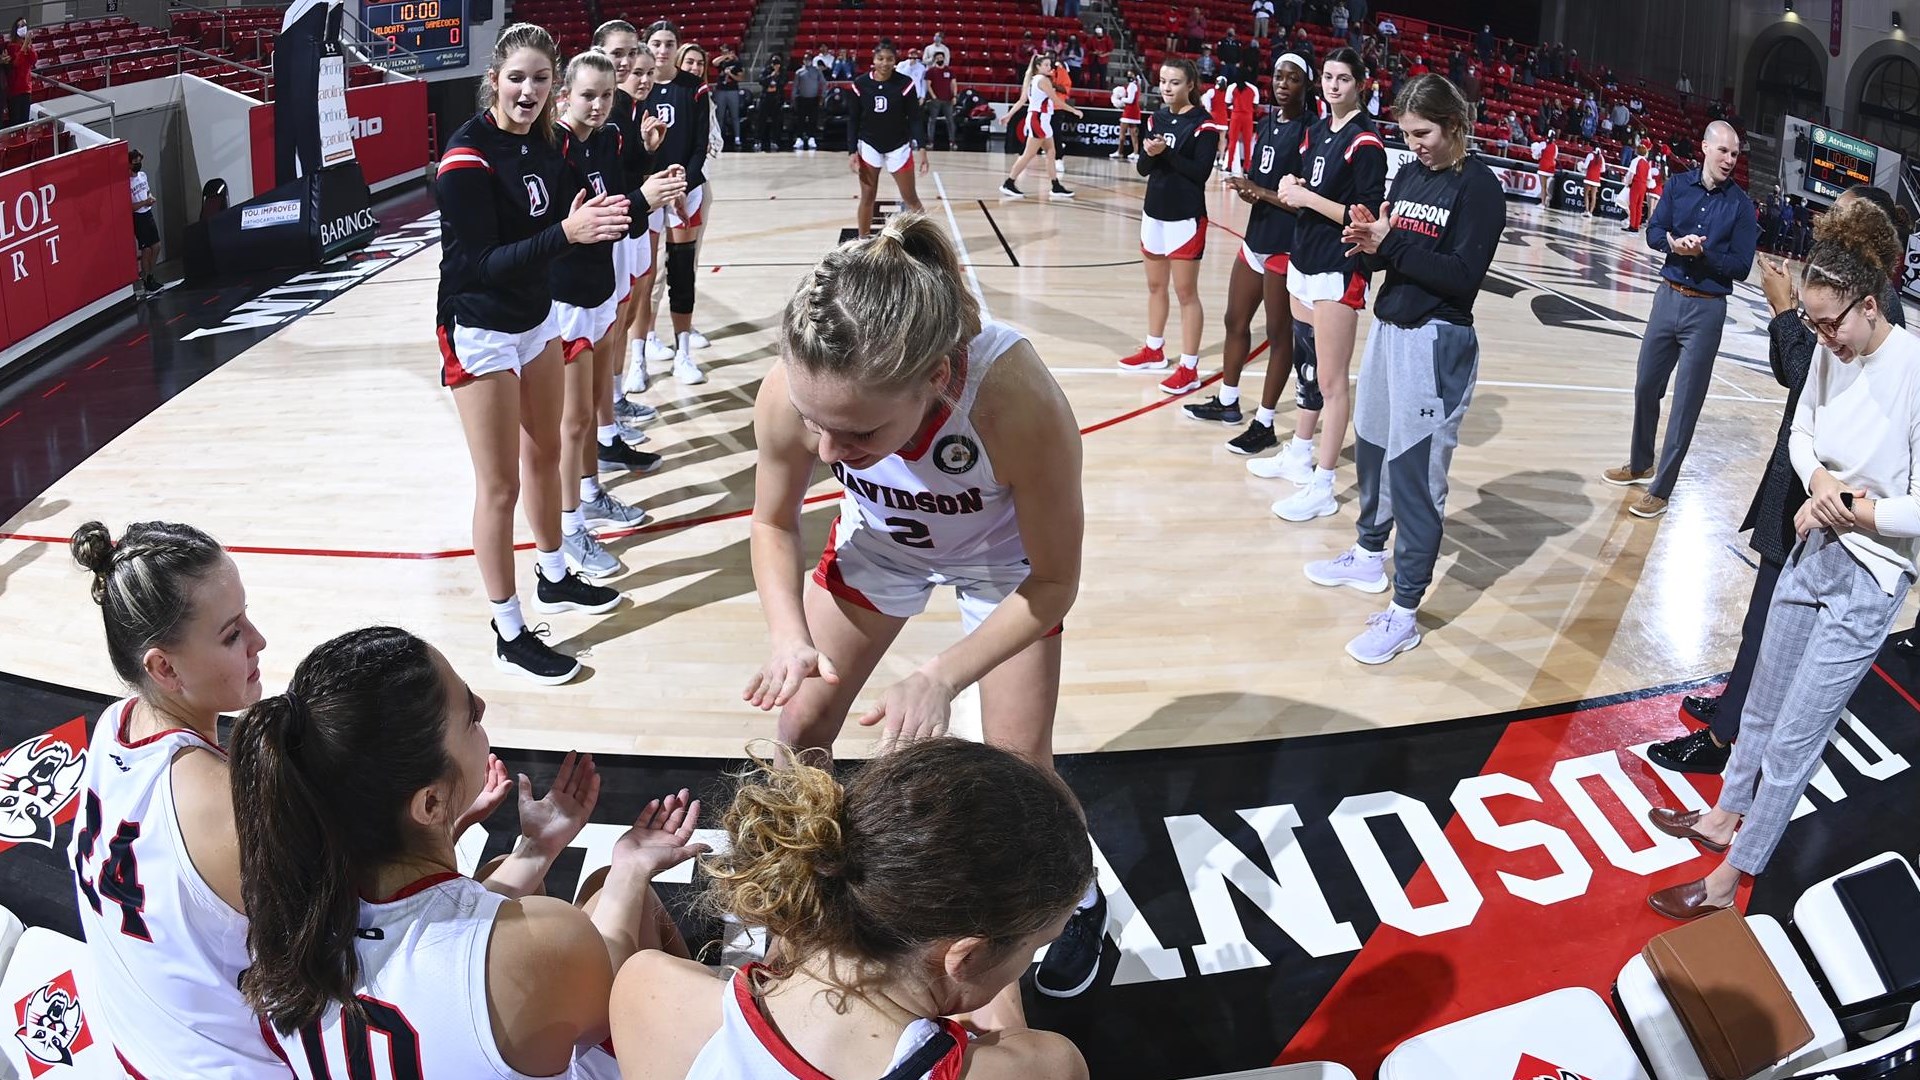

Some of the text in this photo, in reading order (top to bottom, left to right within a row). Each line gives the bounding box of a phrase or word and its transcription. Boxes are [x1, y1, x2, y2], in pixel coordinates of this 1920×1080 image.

[400, 2, 438, 20] 10:00
[450, 28, 460, 44] 0
[1828, 136, 1875, 158] Atrium Health
[1563, 179, 1585, 197] Gre
[1391, 200, 1450, 227] AVIDSON
[320, 208, 374, 246] BARINGS
[1397, 217, 1439, 238] KETBALL
[830, 460, 984, 515] DAVIDSON
[884, 516, 935, 549] 2
